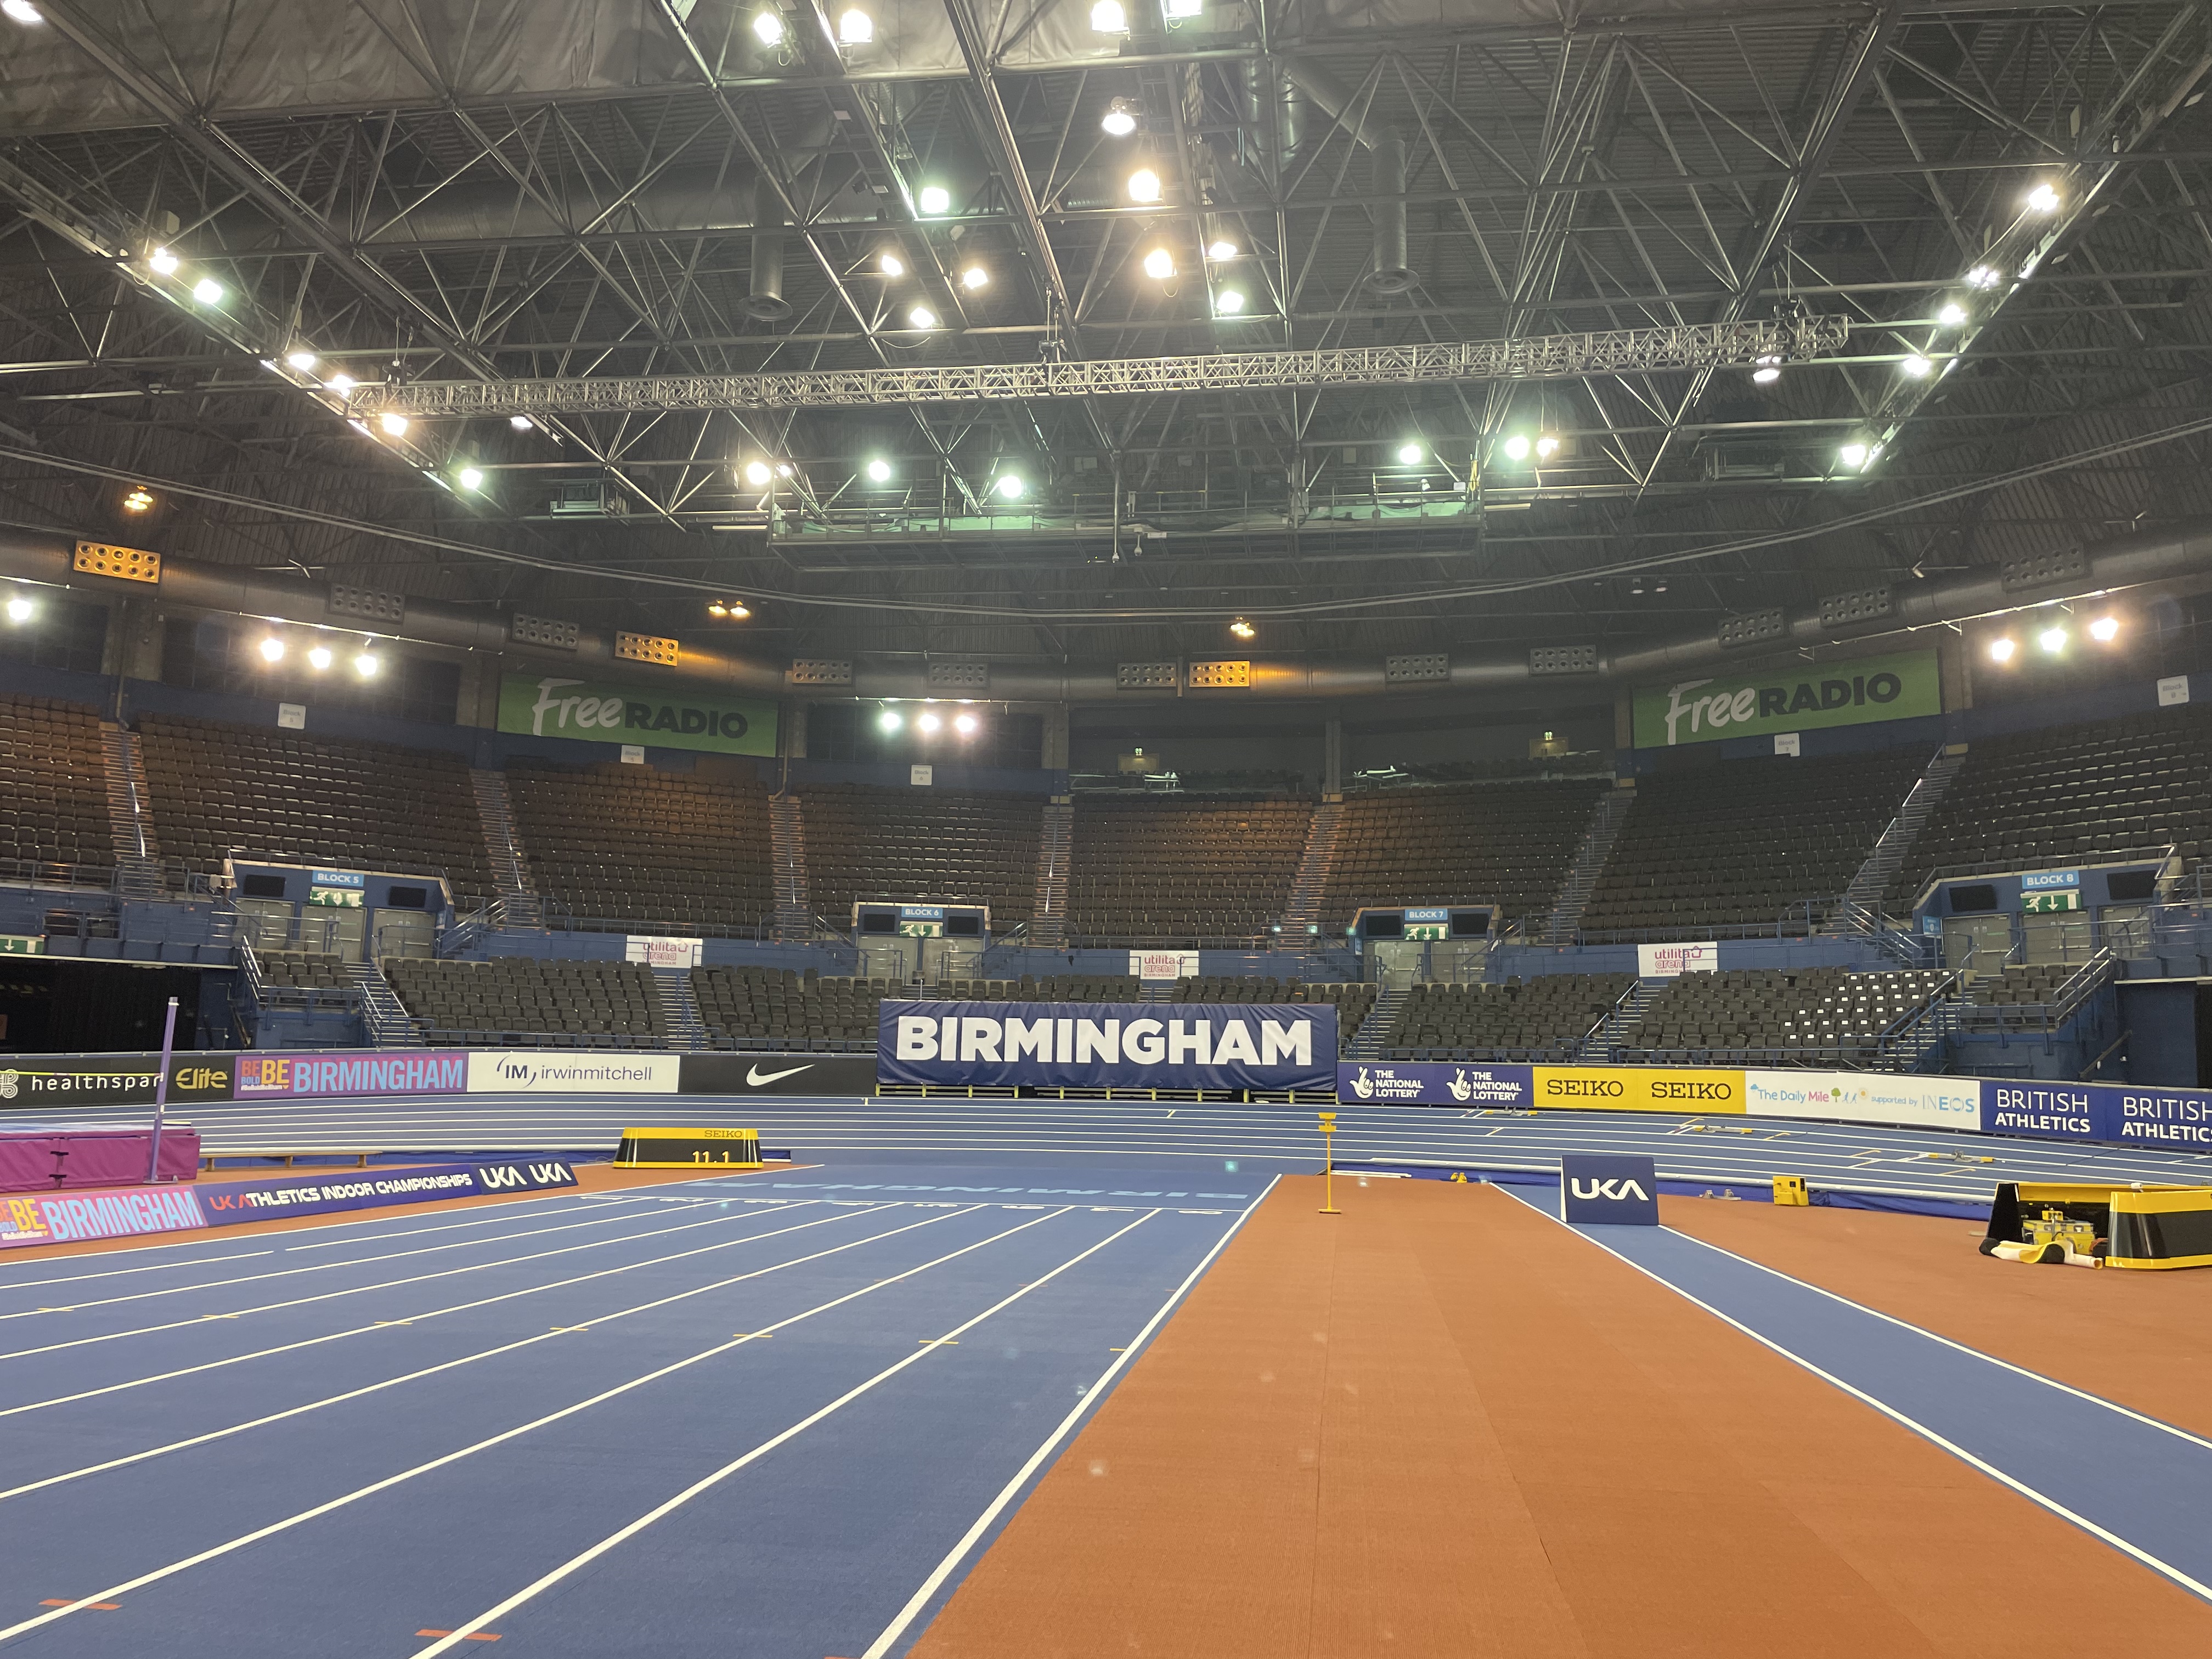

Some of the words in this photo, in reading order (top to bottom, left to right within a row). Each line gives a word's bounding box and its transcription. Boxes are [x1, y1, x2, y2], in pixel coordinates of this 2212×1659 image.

[532, 678, 623, 736] Free
[624, 702, 748, 739] RADIO
[1664, 679, 1756, 745] Free
[1759, 673, 1902, 718] RADIO
[317, 873, 351, 883] BLOCK
[2027, 874, 2063, 886] BLOCK
[2066, 873, 2074, 883] 8
[643, 941, 677, 952] utilita
[1655, 948, 1690, 959] utilita
[1144, 955, 1175, 964] utilita
[1655, 960, 1691, 968] arena
[1144, 964, 1176, 973] arena
[896, 1015, 1312, 1065] BIRMINGHAM
[242, 1060, 261, 1076] BE
[261, 1059, 290, 1084] BE
[294, 1059, 464, 1092] BIRMINGHAM
[505, 1065, 528, 1079] IM
[541, 1065, 652, 1080] irwinmitchell
[1375, 1070, 1394, 1079] THE
[1472, 1071, 1492, 1081] THE
[176, 1068, 228, 1090] Elite
[241, 1076, 260, 1085] BOLD
[1375, 1079, 1424, 1088] NATIONAL
[1473, 1081, 1522, 1092] NATIONAL
[1376, 1088, 1420, 1098] LOTTERY
[1547, 1079, 1623, 1096] SEIKO
[1651, 1082, 1731, 1099] SEIKO
[1474, 1091, 1517, 1101] LOTTERY
[1758, 1089, 1778, 1101] The
[1780, 1090, 1805, 1104] Daily
[1808, 1091, 1830, 1103] Mile
[1871, 1096, 1906, 1105] supported
[1909, 1097, 1918, 1107] by
[1922, 1094, 1975, 1113] INEOS
[1997, 1089, 2088, 1113] BRITISH
[1995, 1113, 2091, 1133] ATHLETICS
[2121, 1121, 2212, 1142] ATHLETIC
[479, 1166, 527, 1188] UKA
[528, 1163, 572, 1184] UKA
[209, 1195, 236, 1210] UK
[239, 1187, 321, 1209] ATHLETICS
[321, 1182, 375, 1200] INDOOR
[375, 1173, 473, 1195] CHAMPIONSHIPS
[1571, 1177, 1649, 1201] UKA
[7, 1198, 47, 1231] BE
[41, 1191, 204, 1240] BIRMINGHAM
